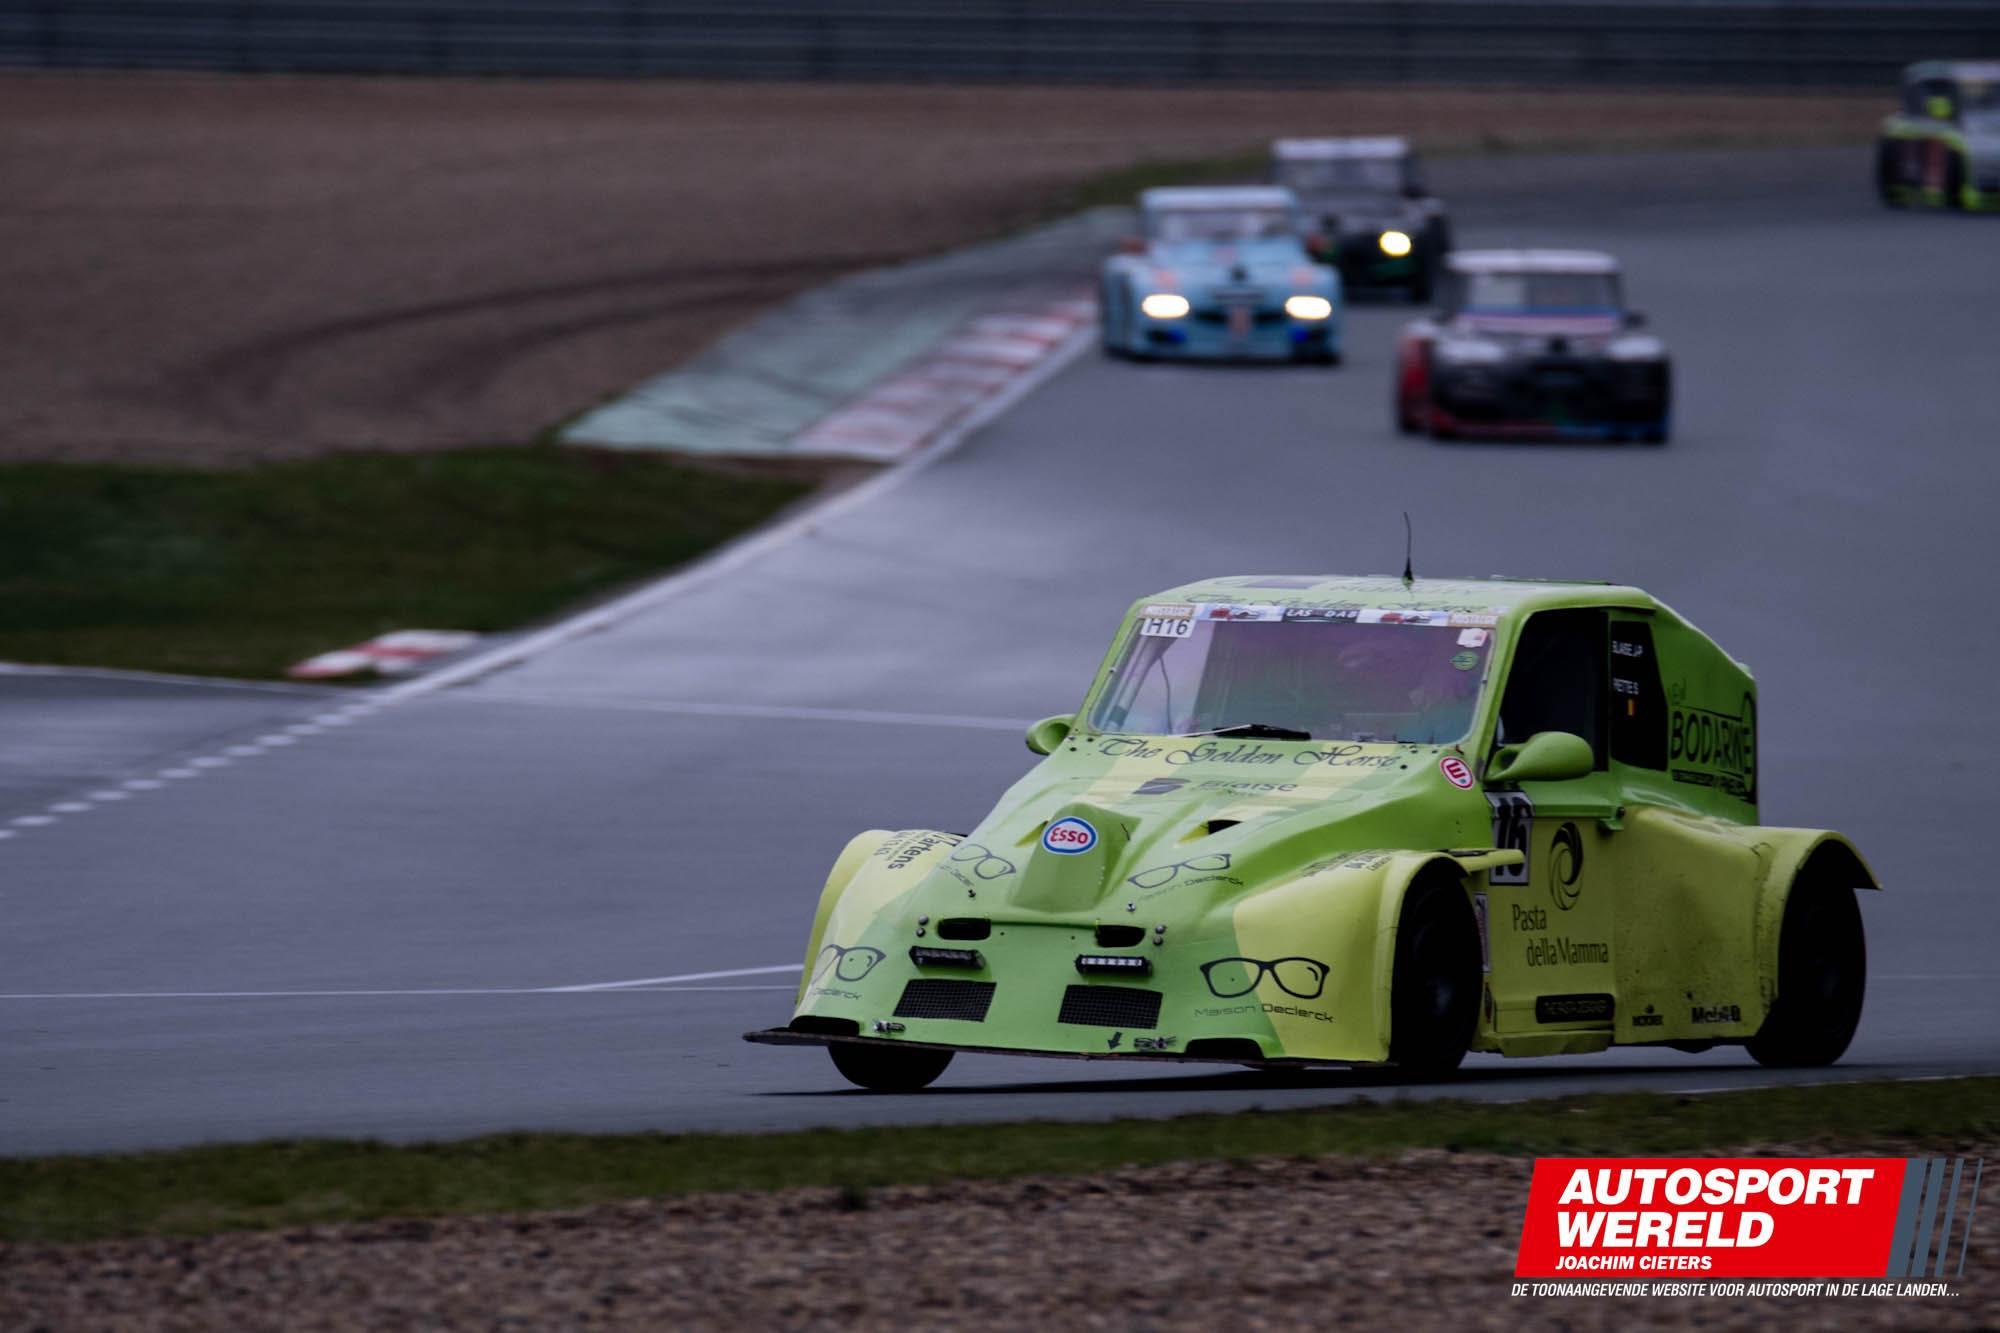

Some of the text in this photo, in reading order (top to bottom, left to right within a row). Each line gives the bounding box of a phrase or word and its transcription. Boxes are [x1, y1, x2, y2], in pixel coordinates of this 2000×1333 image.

[1146, 619, 1189, 636] H16
[1099, 738, 1400, 767] The Golden Horse
[1512, 903, 1548, 931] Pasta
[1527, 936, 1609, 966] della Mamma
[1194, 1003, 1335, 1023] Maison Declerck
